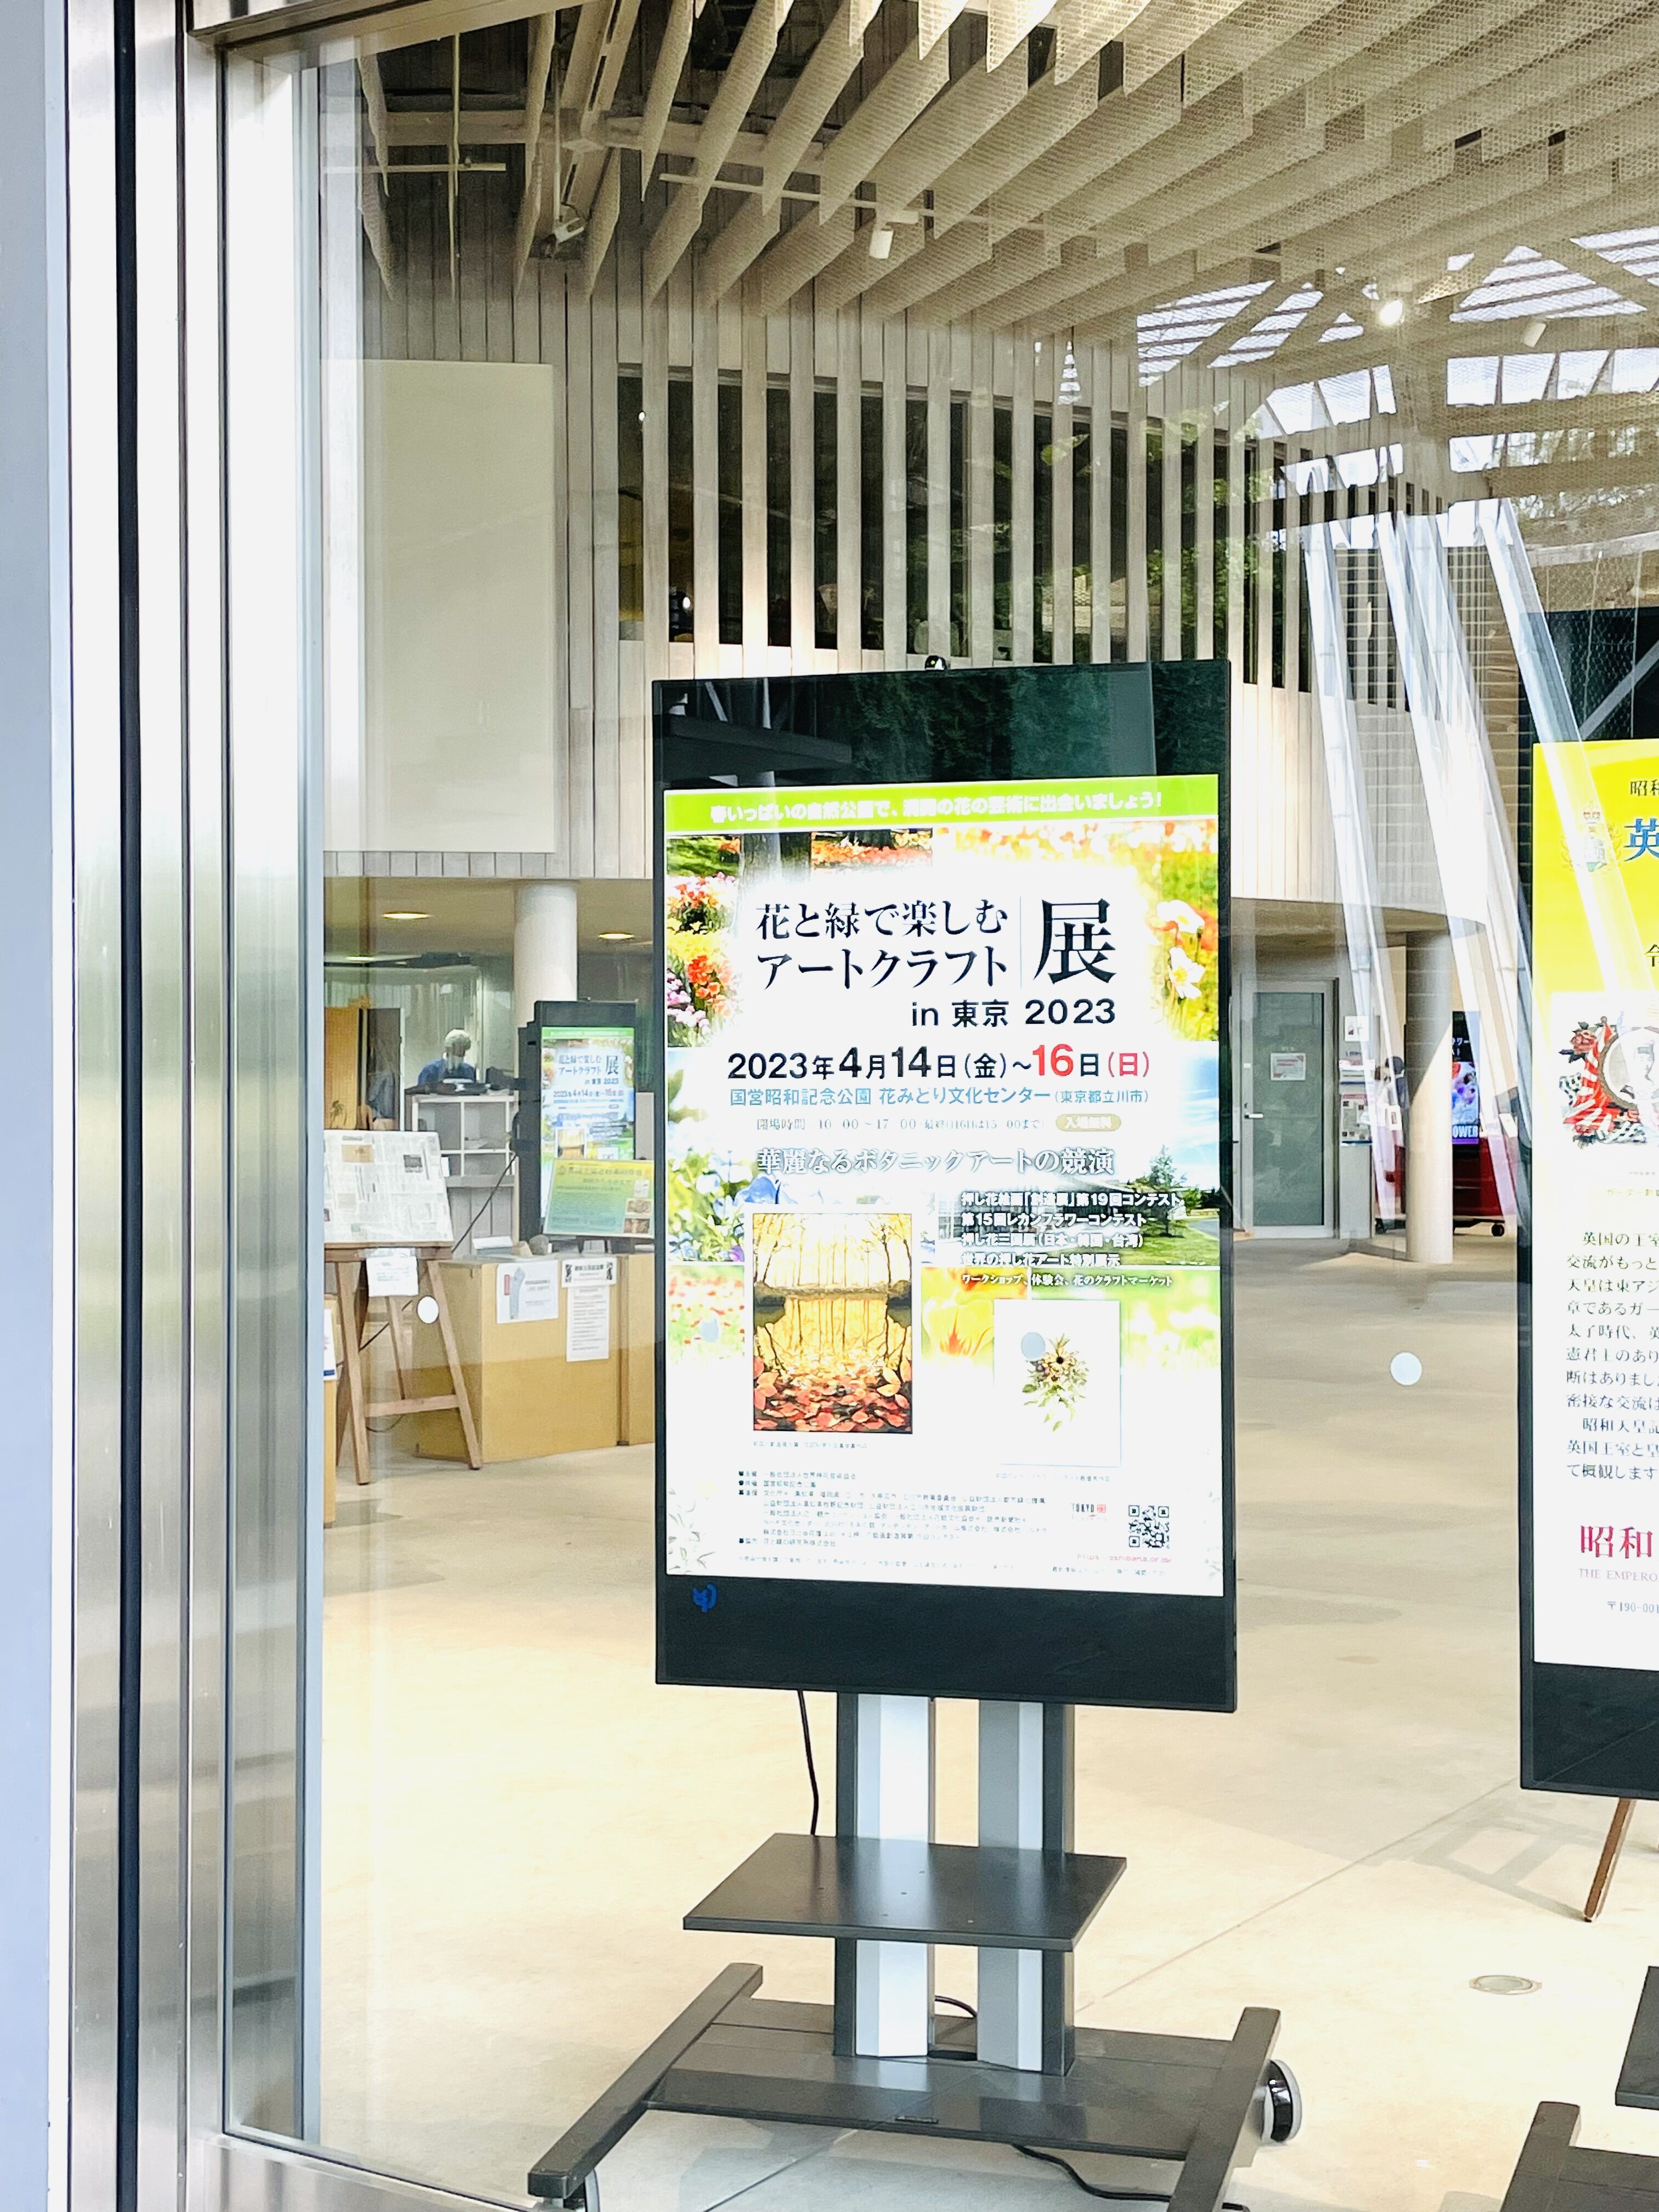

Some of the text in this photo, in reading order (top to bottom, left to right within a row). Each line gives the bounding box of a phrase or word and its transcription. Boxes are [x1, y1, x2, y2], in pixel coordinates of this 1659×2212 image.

[756, 899, 1008, 940] 花と緑で楽しむ
[1033, 898, 1116, 985] 展
[757, 945, 1007, 990] アートクラフト
[911, 998, 1115, 1028] in 東京 2023
[730, 1088, 871, 1106] 国営昭和記念公園
[757, 1147, 1115, 1175] 華麗なるボタニックアートの競演
[1567, 1254, 1657, 1271] 交流がもっと
[1566, 1370, 1659, 1386] 断はありまし
[1566, 1463, 1658, 1480] て概観します
[1581, 1525, 1654, 1559] 昭和
[1578, 1568, 1659, 1582] THE EMPERO
